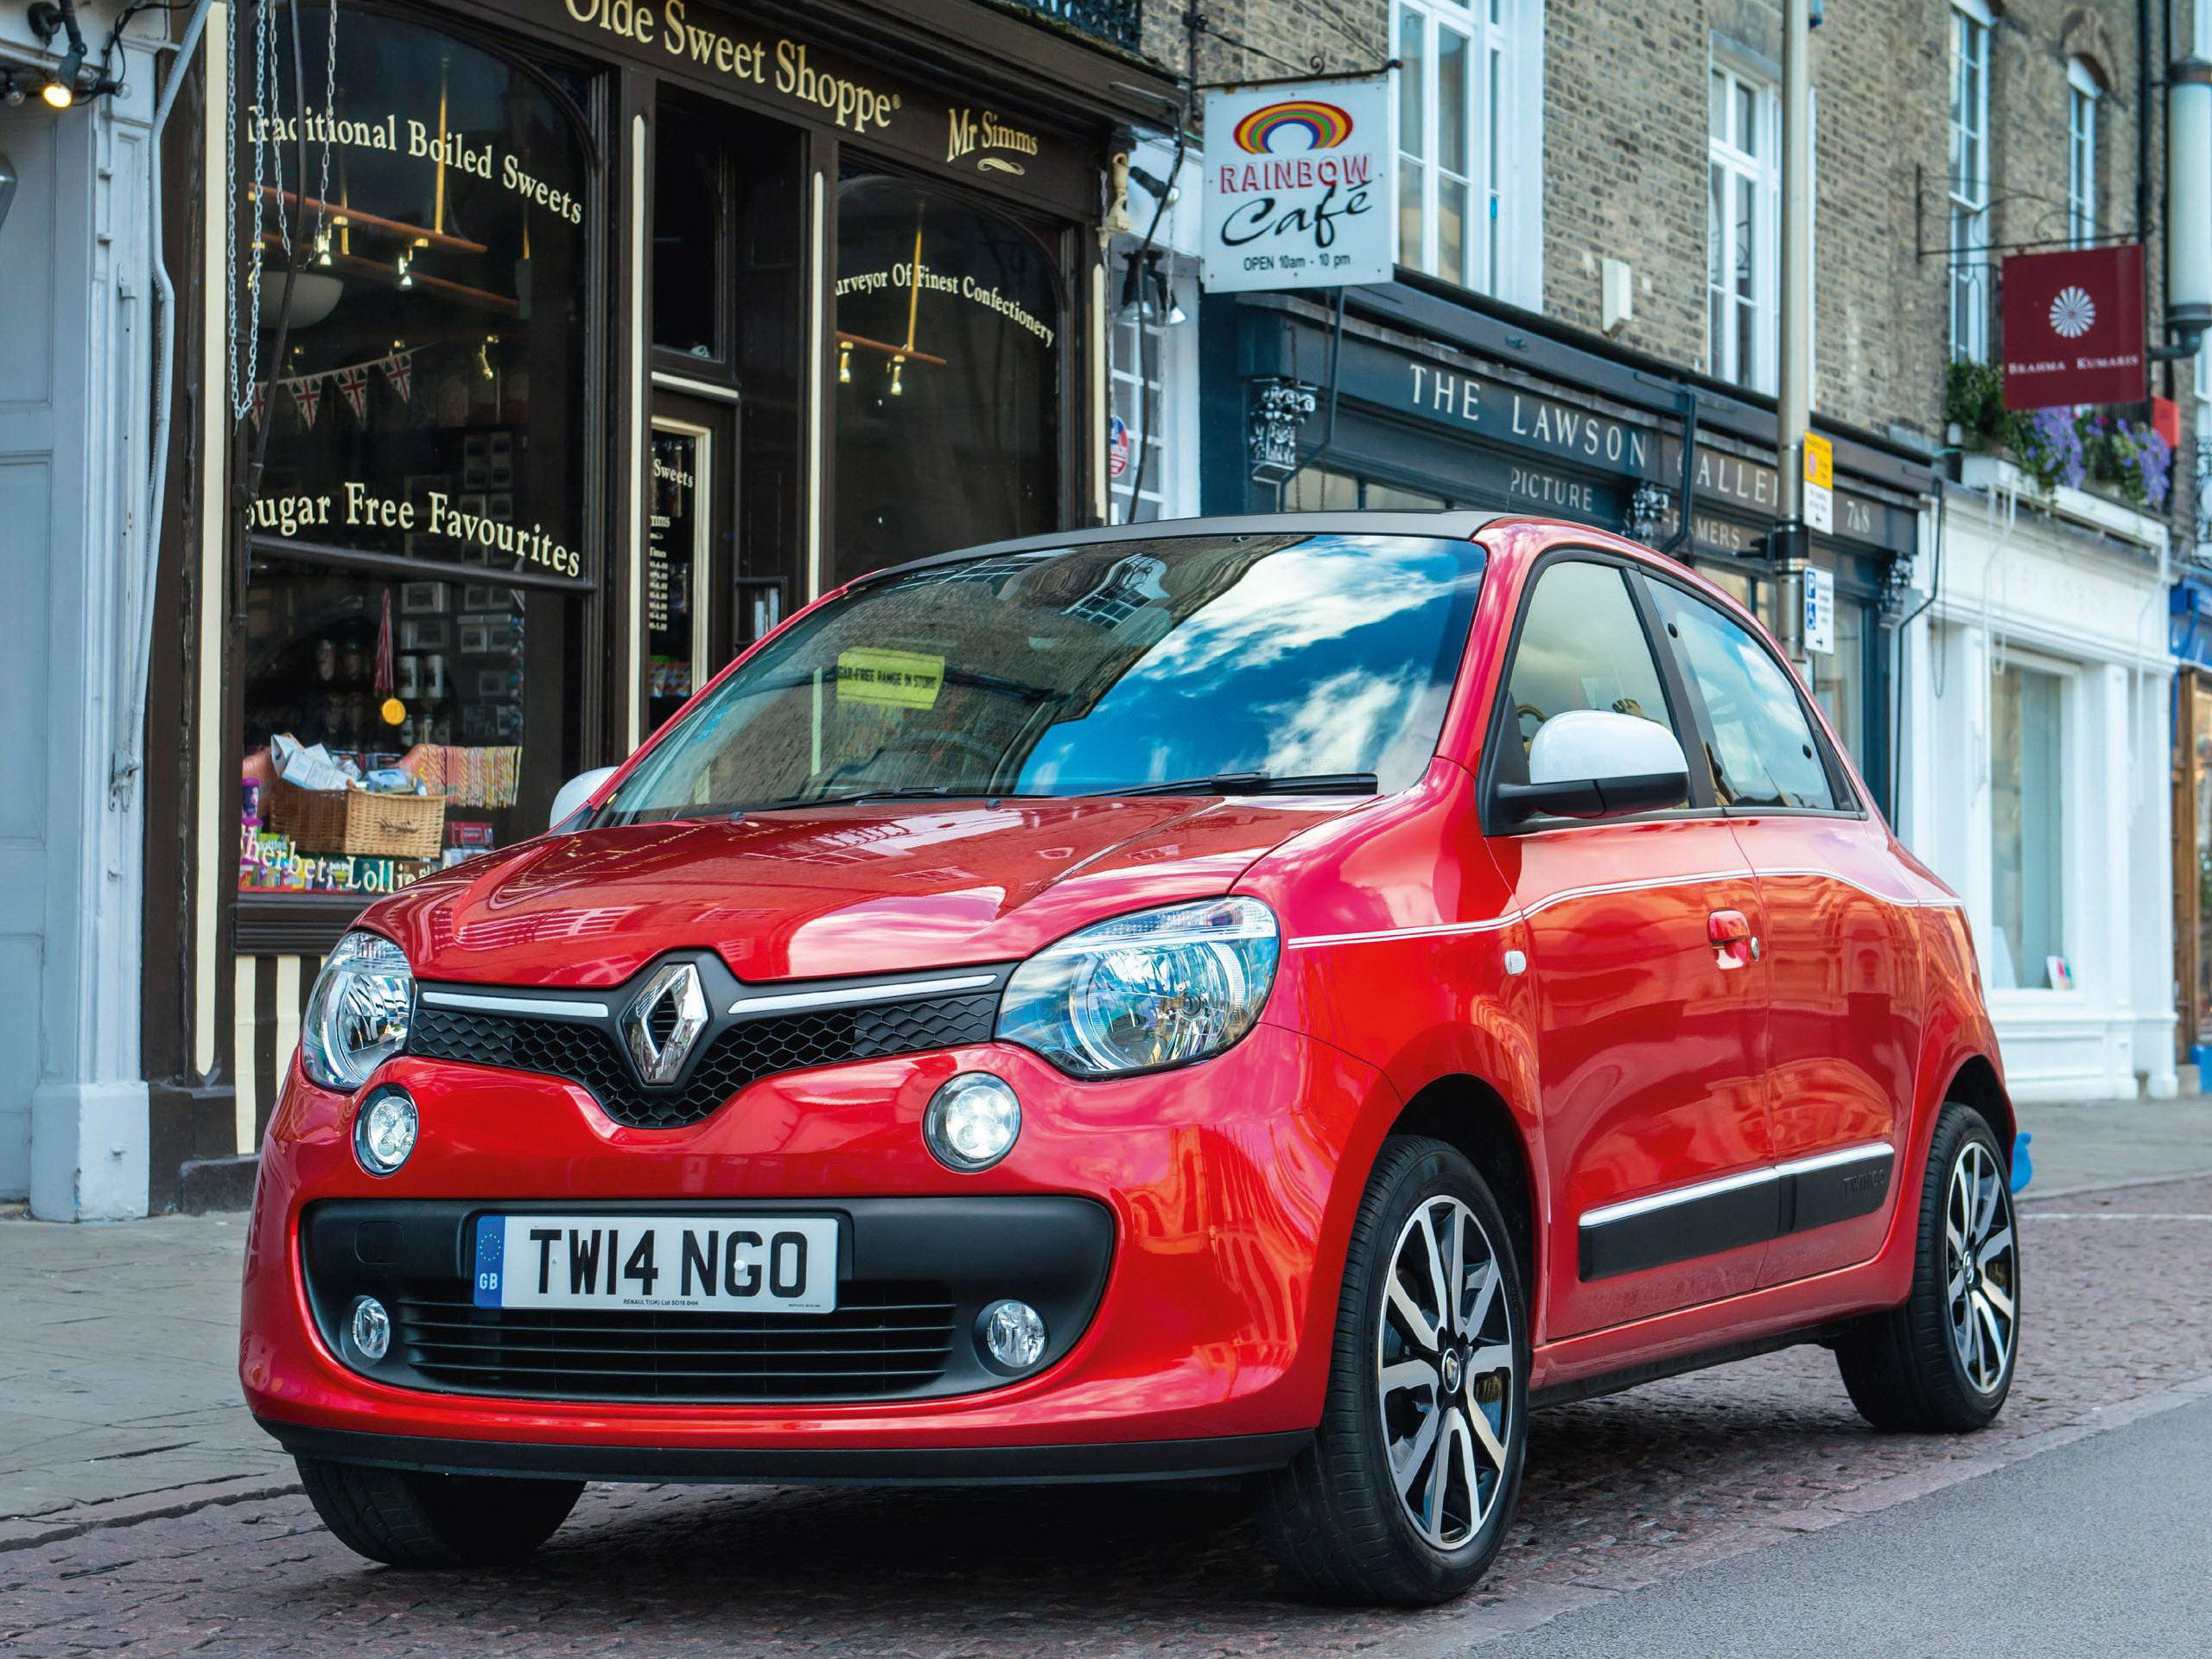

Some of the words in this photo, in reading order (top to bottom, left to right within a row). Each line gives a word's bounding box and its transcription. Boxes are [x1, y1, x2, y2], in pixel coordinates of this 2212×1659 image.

[664, 0, 766, 85] Sweet
[946, 108, 978, 162] Mr
[982, 111, 1038, 156] Simms
[408, 119, 493, 180] Boiled
[503, 155, 582, 225] Sweets
[1220, 155, 1371, 194] RAINBOW
[1220, 179, 1373, 249] Café
[1243, 257, 1274, 271] OPEN
[1280, 255, 1306, 269] 10am
[1319, 254, 1329, 267] 10
[1333, 254, 1351, 269] pm
[836, 271, 888, 296] urveyor
[892, 263, 912, 287] Of
[916, 264, 959, 295] Finest
[963, 276, 1055, 348] Confectionery
[1409, 364, 1479, 422] THE
[1512, 394, 1647, 468] LAWSON
[1676, 451, 1779, 509] ALLE
[653, 458, 694, 488] Sweets
[1510, 467, 1593, 512] PICTURE
[345, 481, 415, 530] Free
[428, 490, 581, 578] Favourites
[480, 1273, 499, 1290] GB
[680, 1230, 809, 1299] NGO
